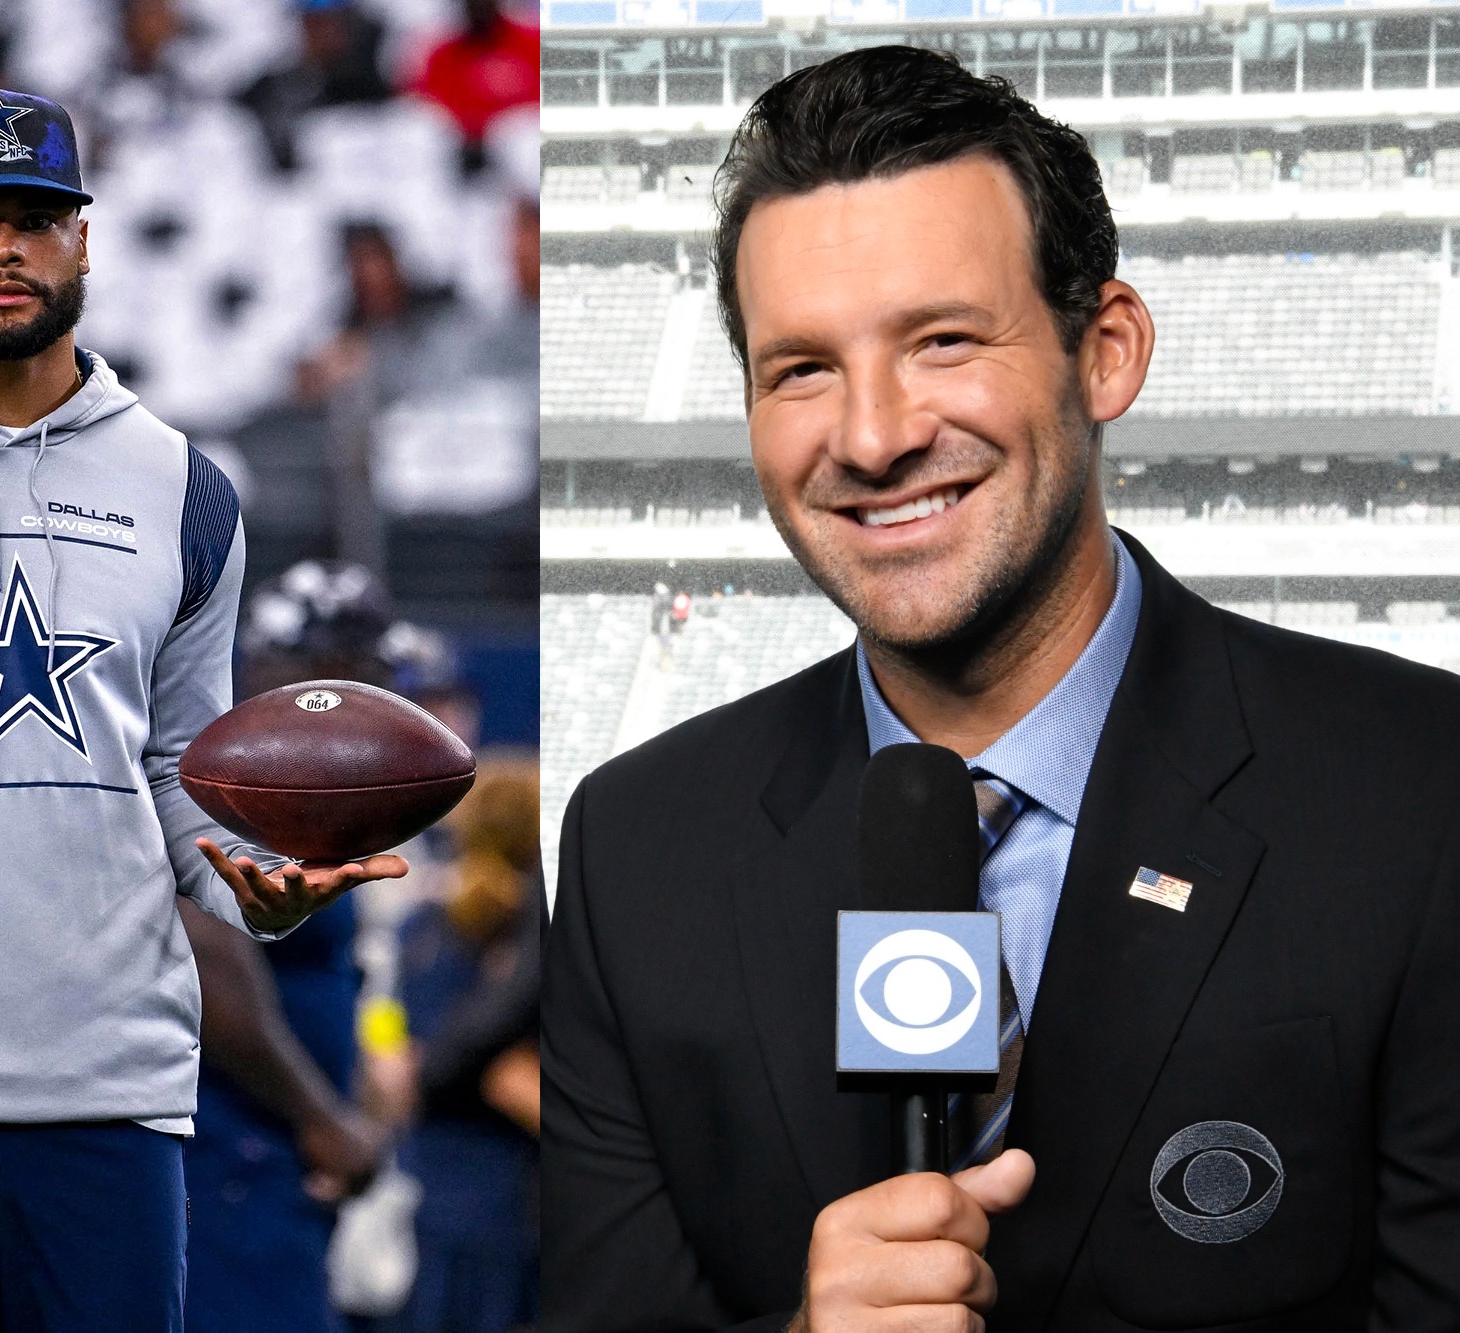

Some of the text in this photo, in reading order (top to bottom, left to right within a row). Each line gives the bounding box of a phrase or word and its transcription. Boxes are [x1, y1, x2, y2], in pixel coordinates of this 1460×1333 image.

[10, 147, 27, 158] NFC
[47, 501, 135, 523] DALLAS
[20, 515, 137, 543] COWBOYS
[306, 699, 329, 710] 064
